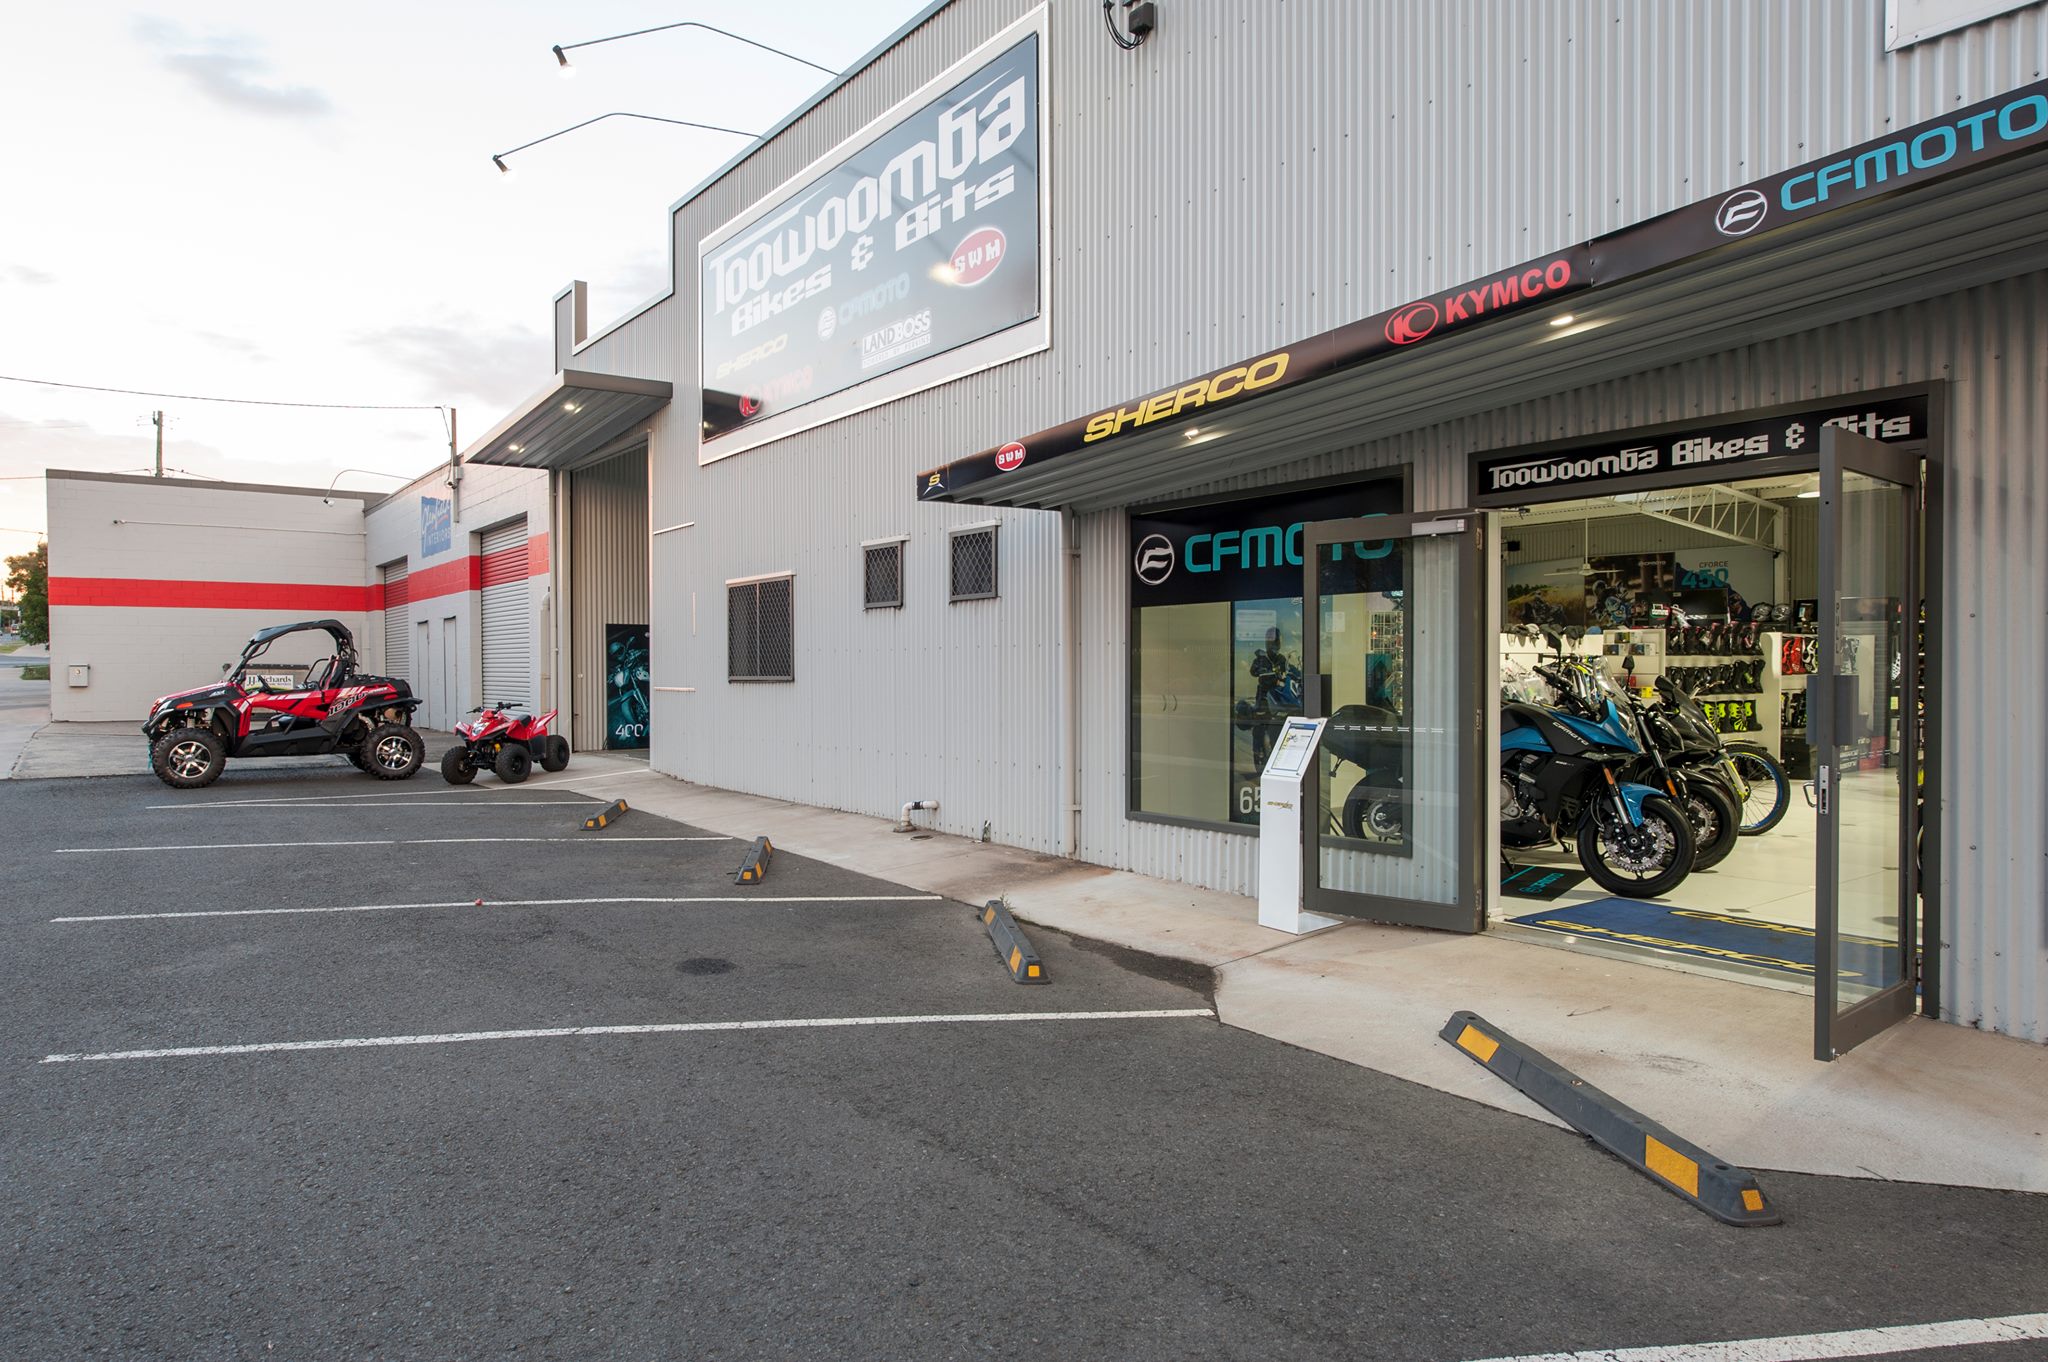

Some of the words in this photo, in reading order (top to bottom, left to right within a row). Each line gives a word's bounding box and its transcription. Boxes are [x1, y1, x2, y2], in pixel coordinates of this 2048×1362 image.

[1780, 94, 2048, 211] CFMOTO
[708, 66, 1025, 316] Toowoomba
[731, 264, 832, 337] Bikes
[851, 234, 873, 272] &
[895, 164, 1015, 251] Bits
[954, 238, 1002, 275] SWM
[1445, 259, 1571, 324] KYMCO
[863, 310, 931, 355] LANDBOSS
[1084, 353, 1290, 443] SHERCO
[1488, 445, 1659, 490] Toowoomba
[1671, 434, 1769, 466] Bikes
[1785, 422, 1805, 449] &
[1681, 567, 1729, 589] 450
[1698, 560, 1729, 569] CFORCE
[615, 724, 644, 738] 400
